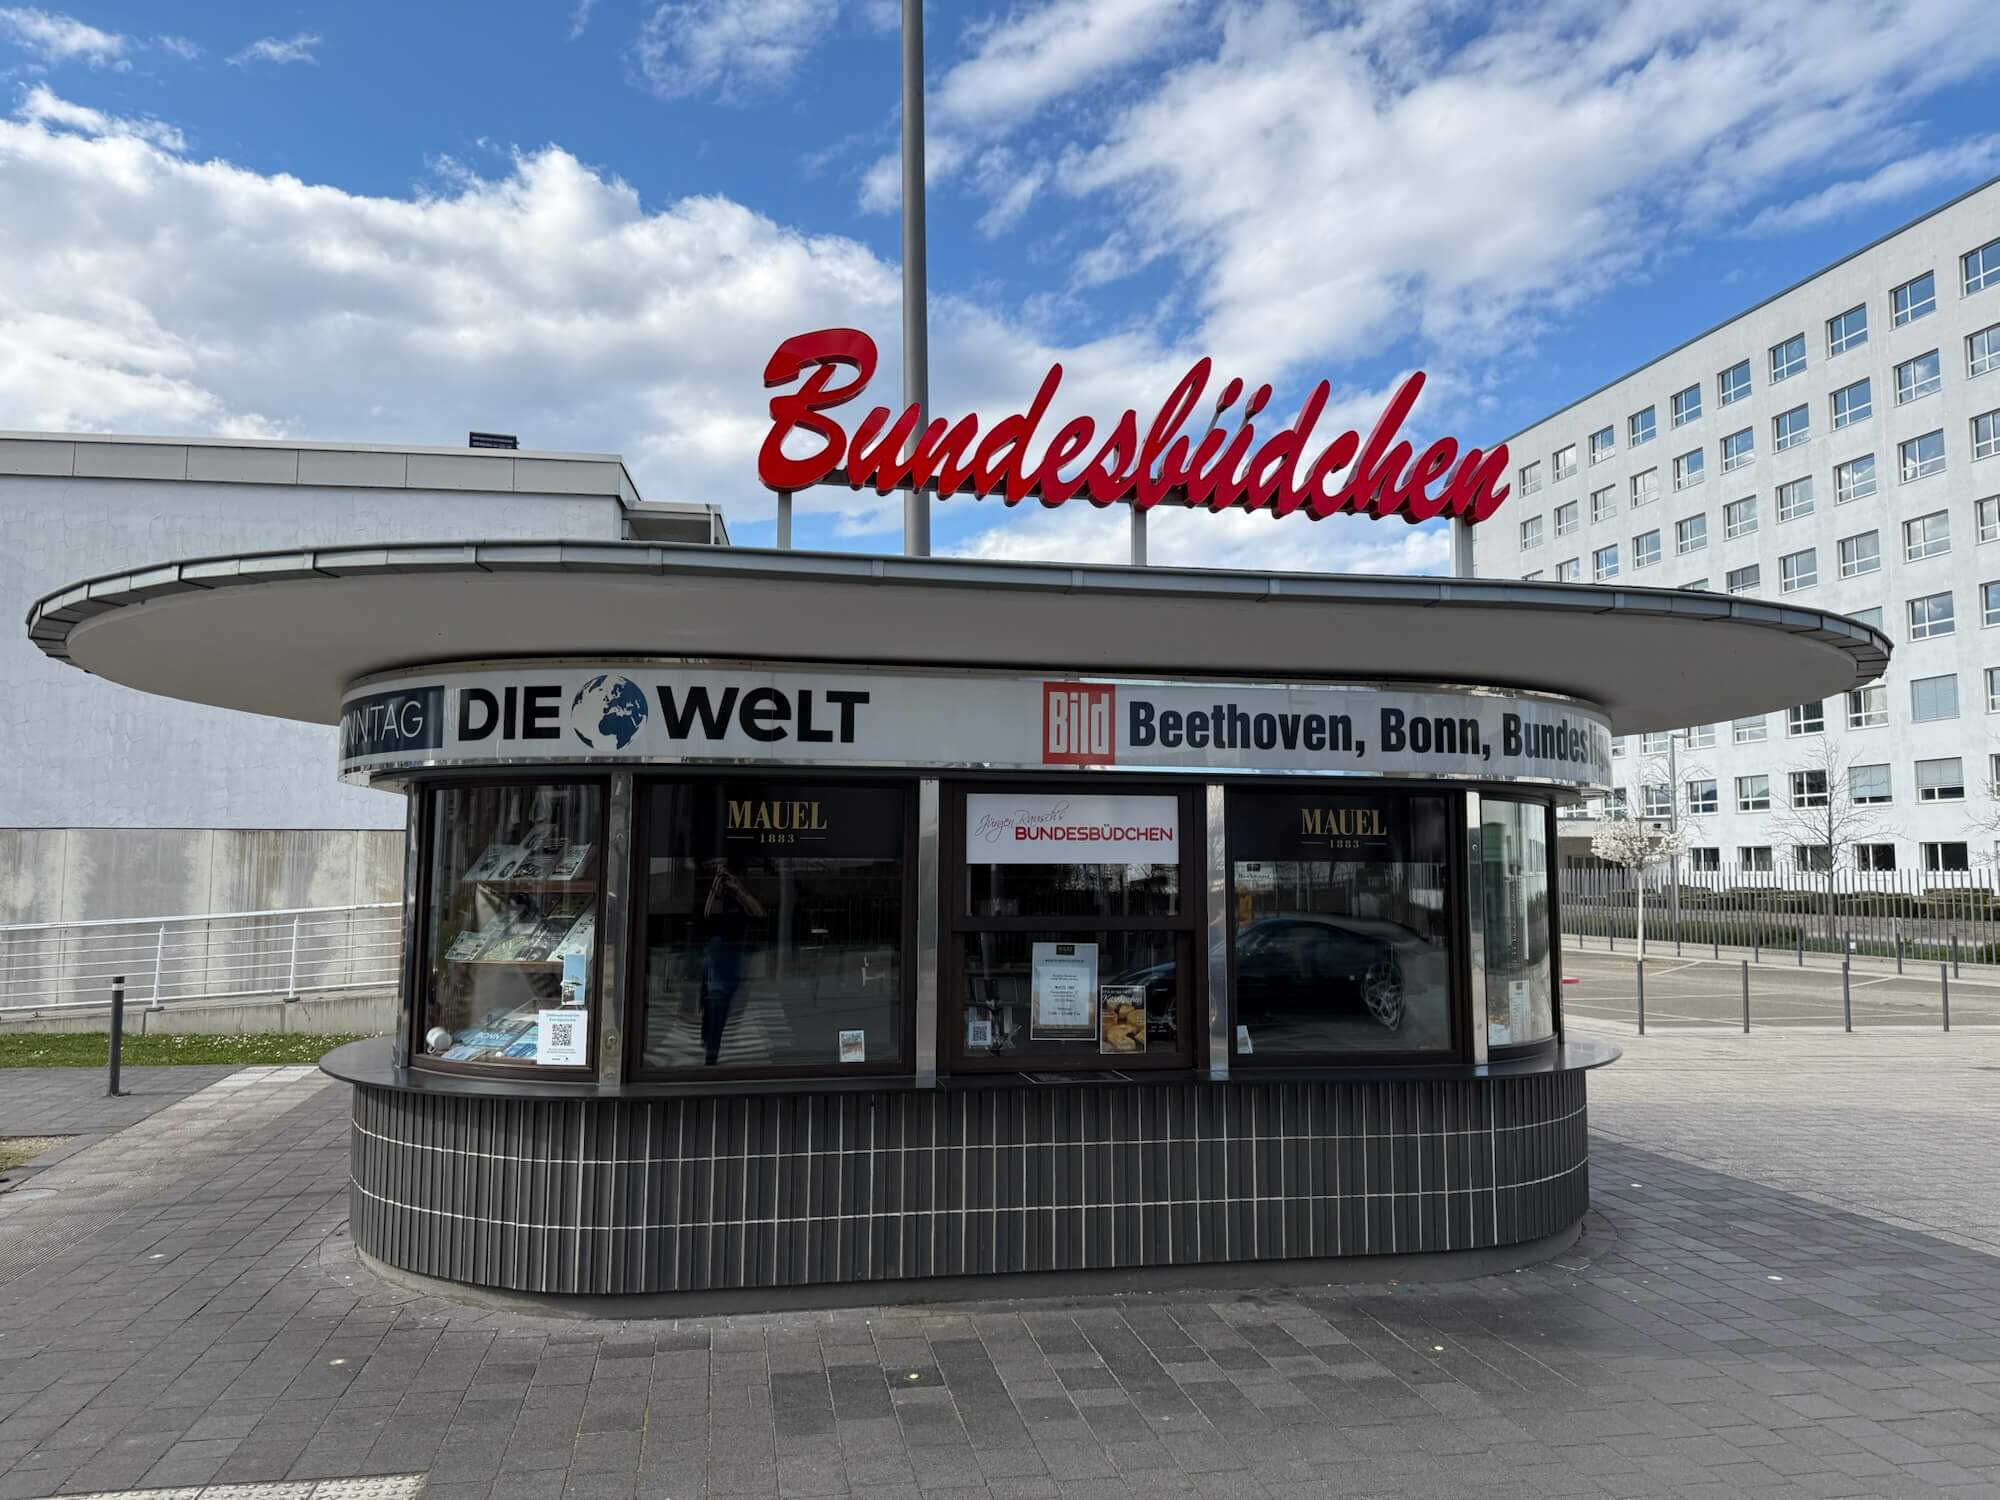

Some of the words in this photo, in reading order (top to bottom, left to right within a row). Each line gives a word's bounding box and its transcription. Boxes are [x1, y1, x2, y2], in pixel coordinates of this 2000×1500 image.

[757, 327, 1510, 524] Bundesbüdchen
[458, 685, 562, 742] DIE
[1049, 692, 1109, 755] Bild
[1129, 701, 1364, 758] Beethoven,
[1381, 707, 1491, 761] Bonn,
[727, 800, 828, 830] MAUEL
[1300, 808, 1387, 836] MAUEL
[760, 833, 795, 844] 1883
[1015, 824, 1174, 842] BUNDESBÜDCHEN
[1330, 839, 1360, 849] 1883
